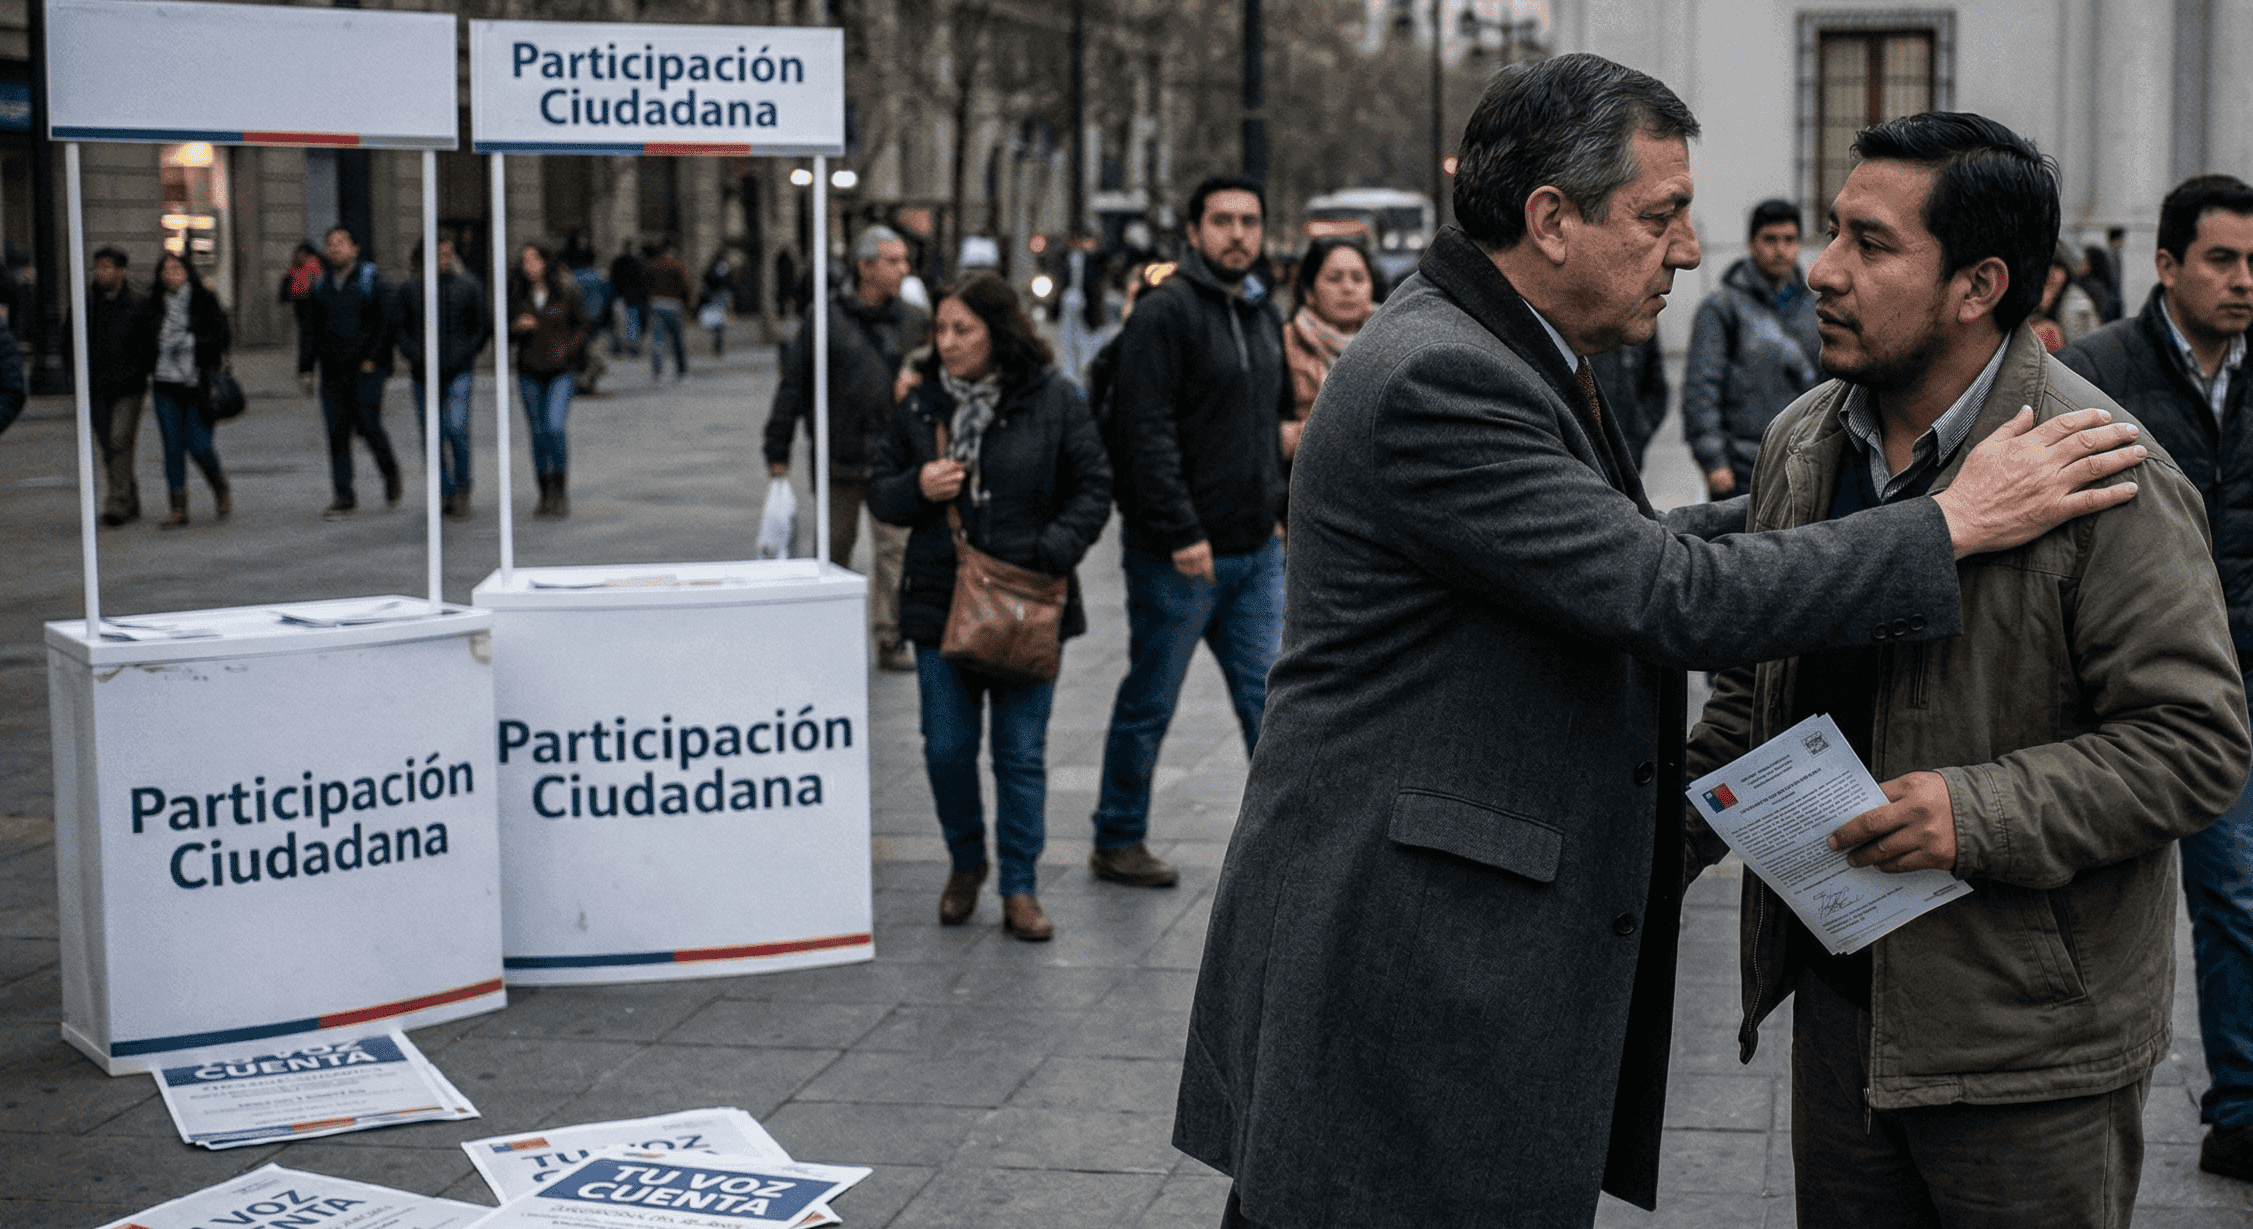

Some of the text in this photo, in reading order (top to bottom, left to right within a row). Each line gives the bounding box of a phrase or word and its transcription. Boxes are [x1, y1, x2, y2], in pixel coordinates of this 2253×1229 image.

[513, 42, 804, 90] Participación
[540, 88, 778, 127] Ciudadana
[498, 705, 854, 770] Participación
[130, 752, 475, 835] Participación
[532, 767, 824, 818] Ciudadana
[169, 822, 450, 890] Ciudadana
[194, 1050, 378, 1080] CUENTA
[577, 1182, 770, 1217] CUENTA
[613, 1165, 797, 1198] TU VOZ
[209, 1189, 319, 1225] VOZ
